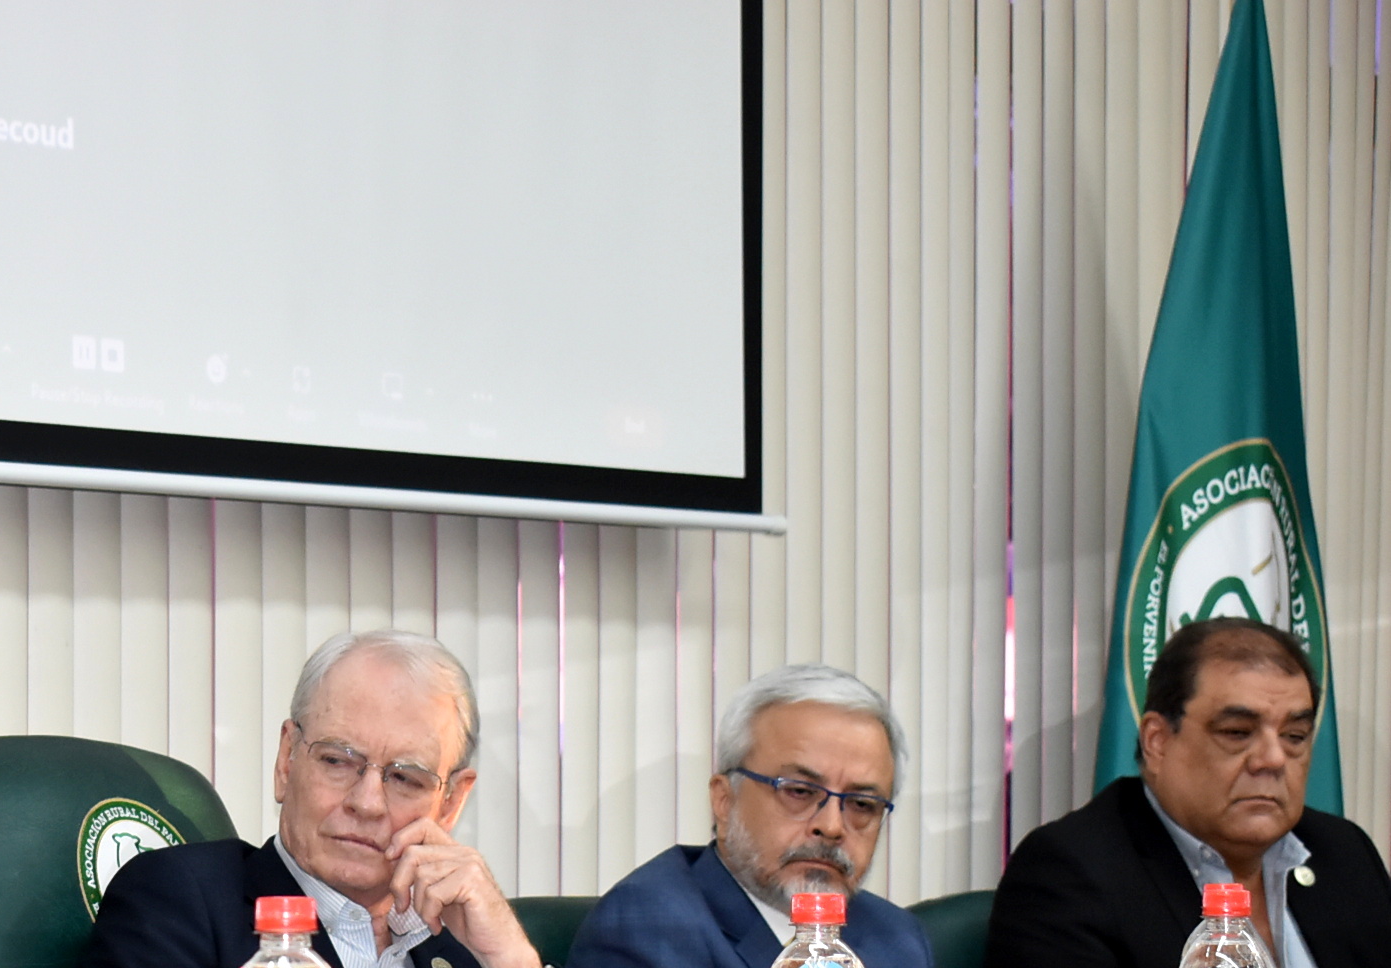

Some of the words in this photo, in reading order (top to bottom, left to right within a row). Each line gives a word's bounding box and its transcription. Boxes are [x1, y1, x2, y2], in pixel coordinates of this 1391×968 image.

[85, 812, 108, 889] ASOCIACIÓN
[104, 806, 139, 821] RURAL
[140, 811, 161, 831] DEL
